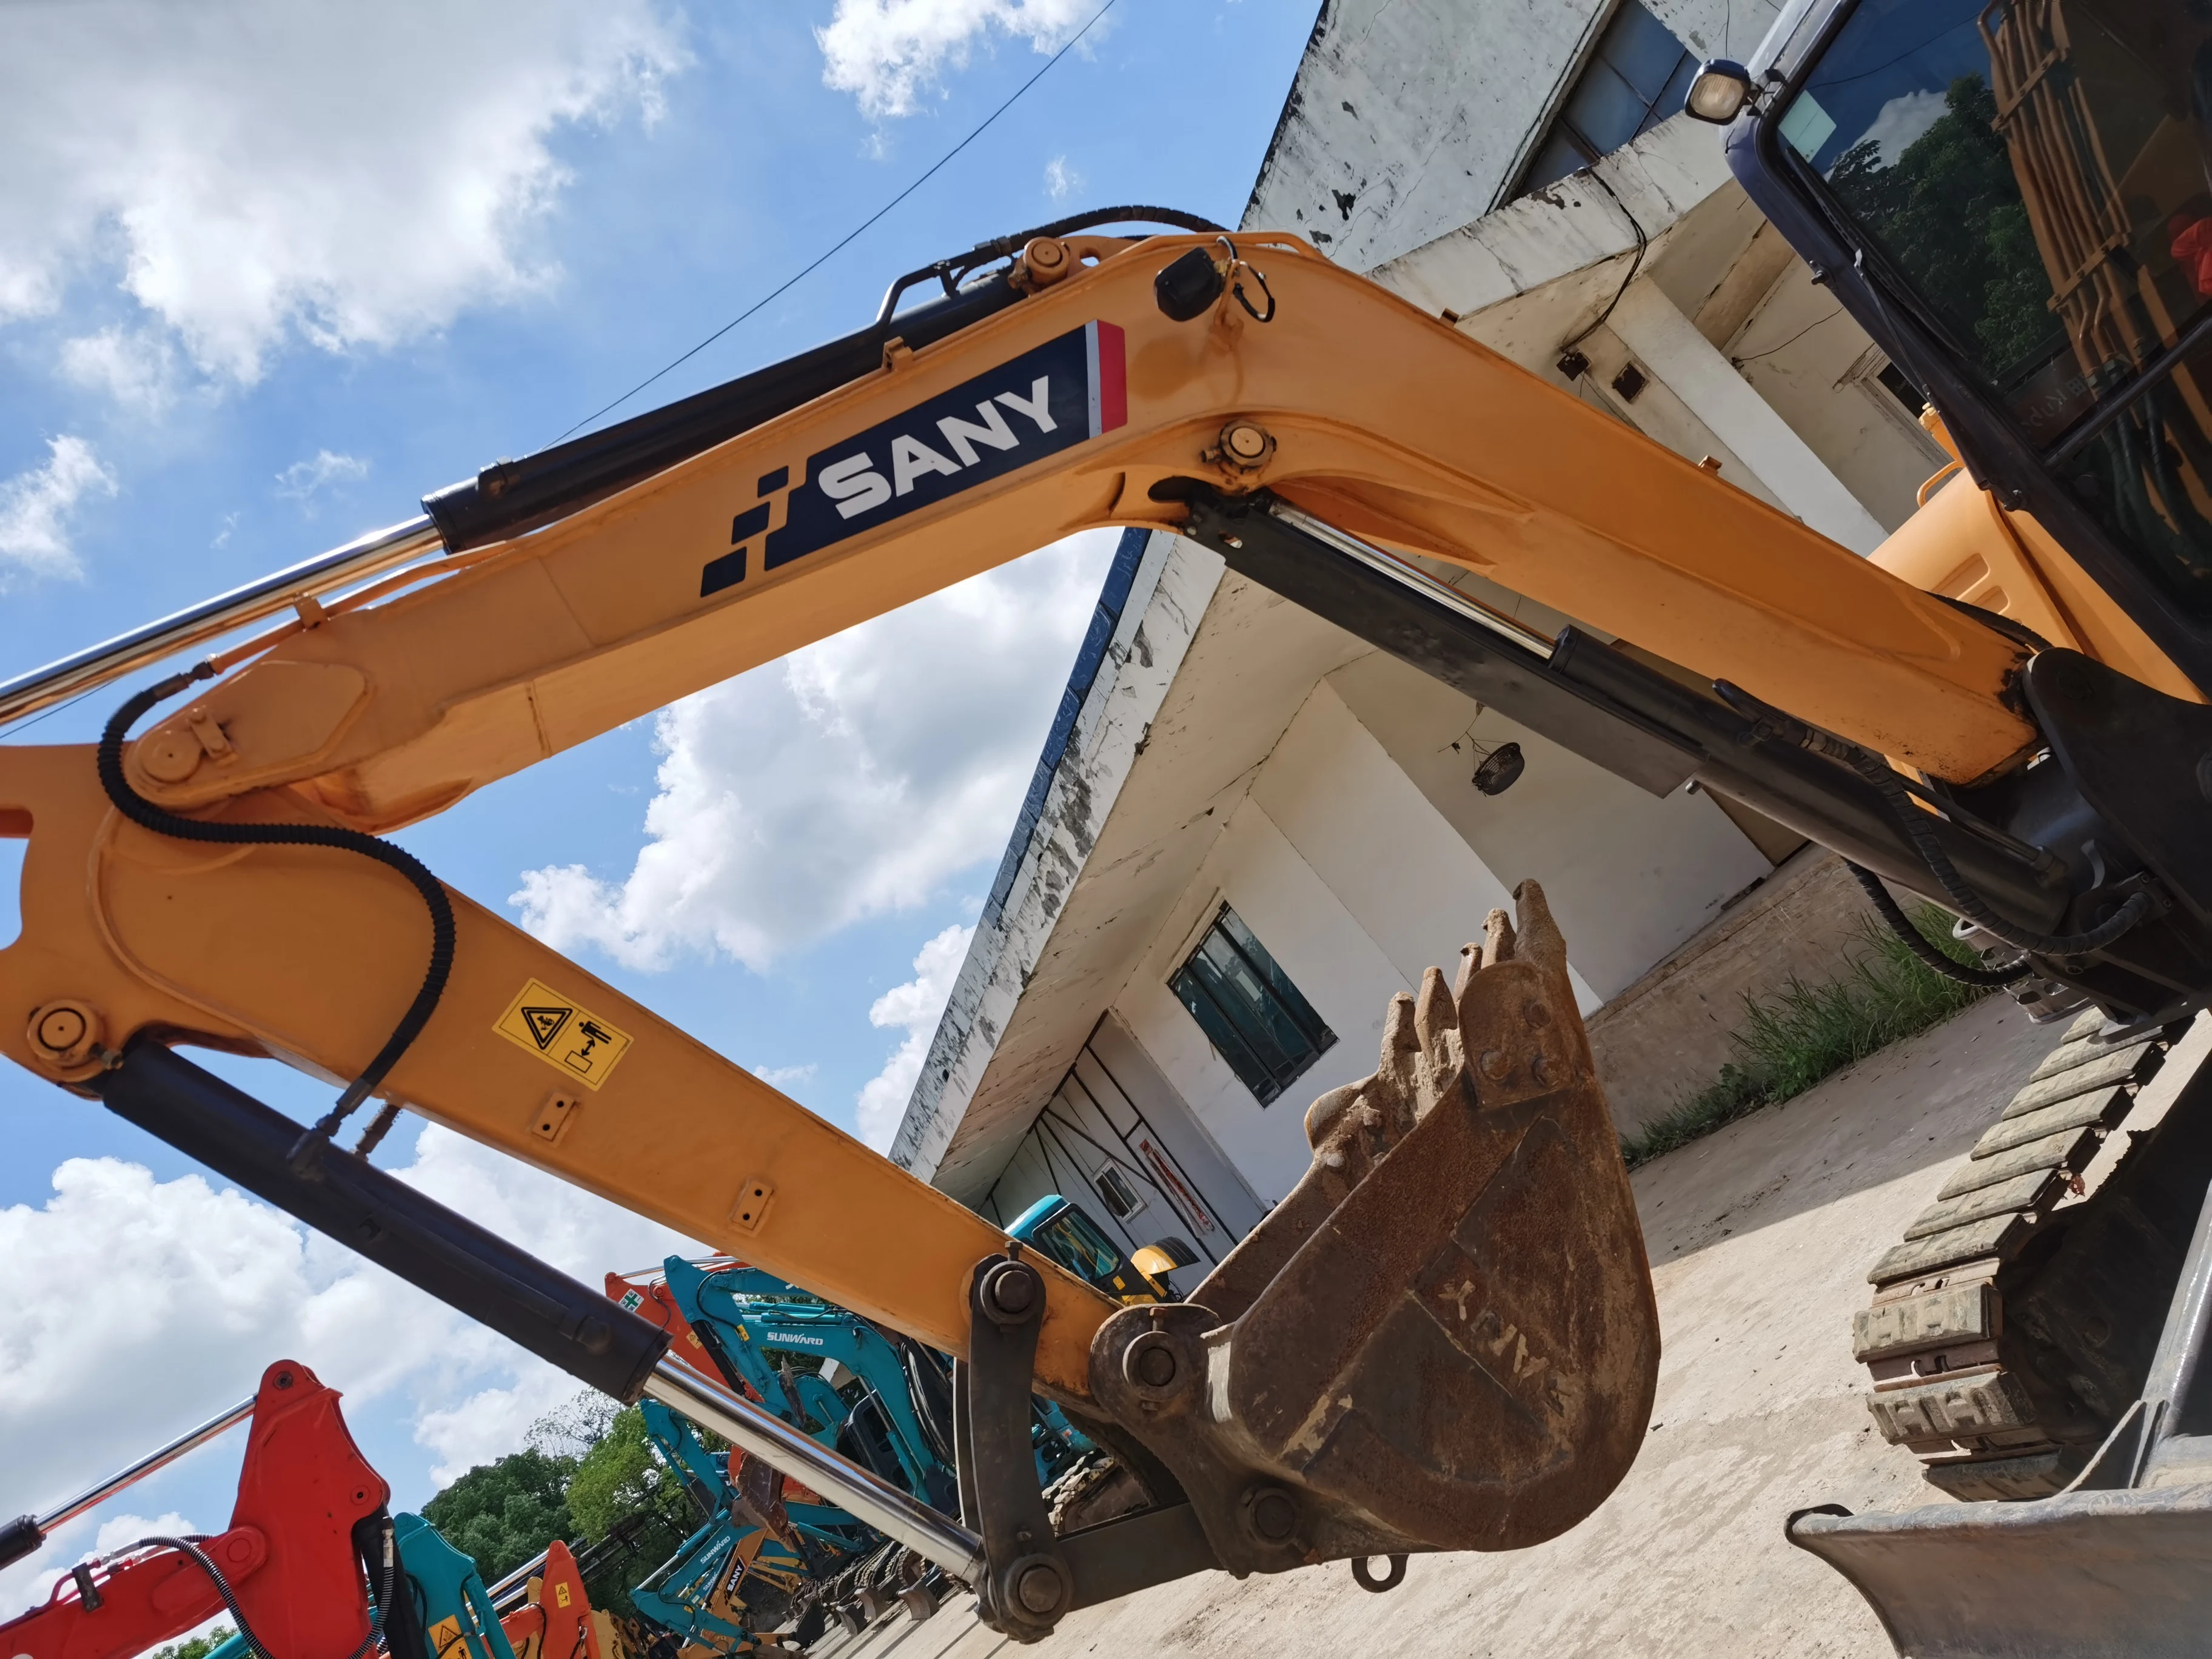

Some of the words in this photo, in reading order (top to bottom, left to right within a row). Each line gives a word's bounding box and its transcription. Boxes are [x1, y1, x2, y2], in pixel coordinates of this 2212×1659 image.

[819, 375, 1057, 520] SANY
[767, 1332, 823, 1346] SUNWARD
[700, 1536, 731, 1564] SUNWARD
[728, 1564, 743, 1592] SANY
